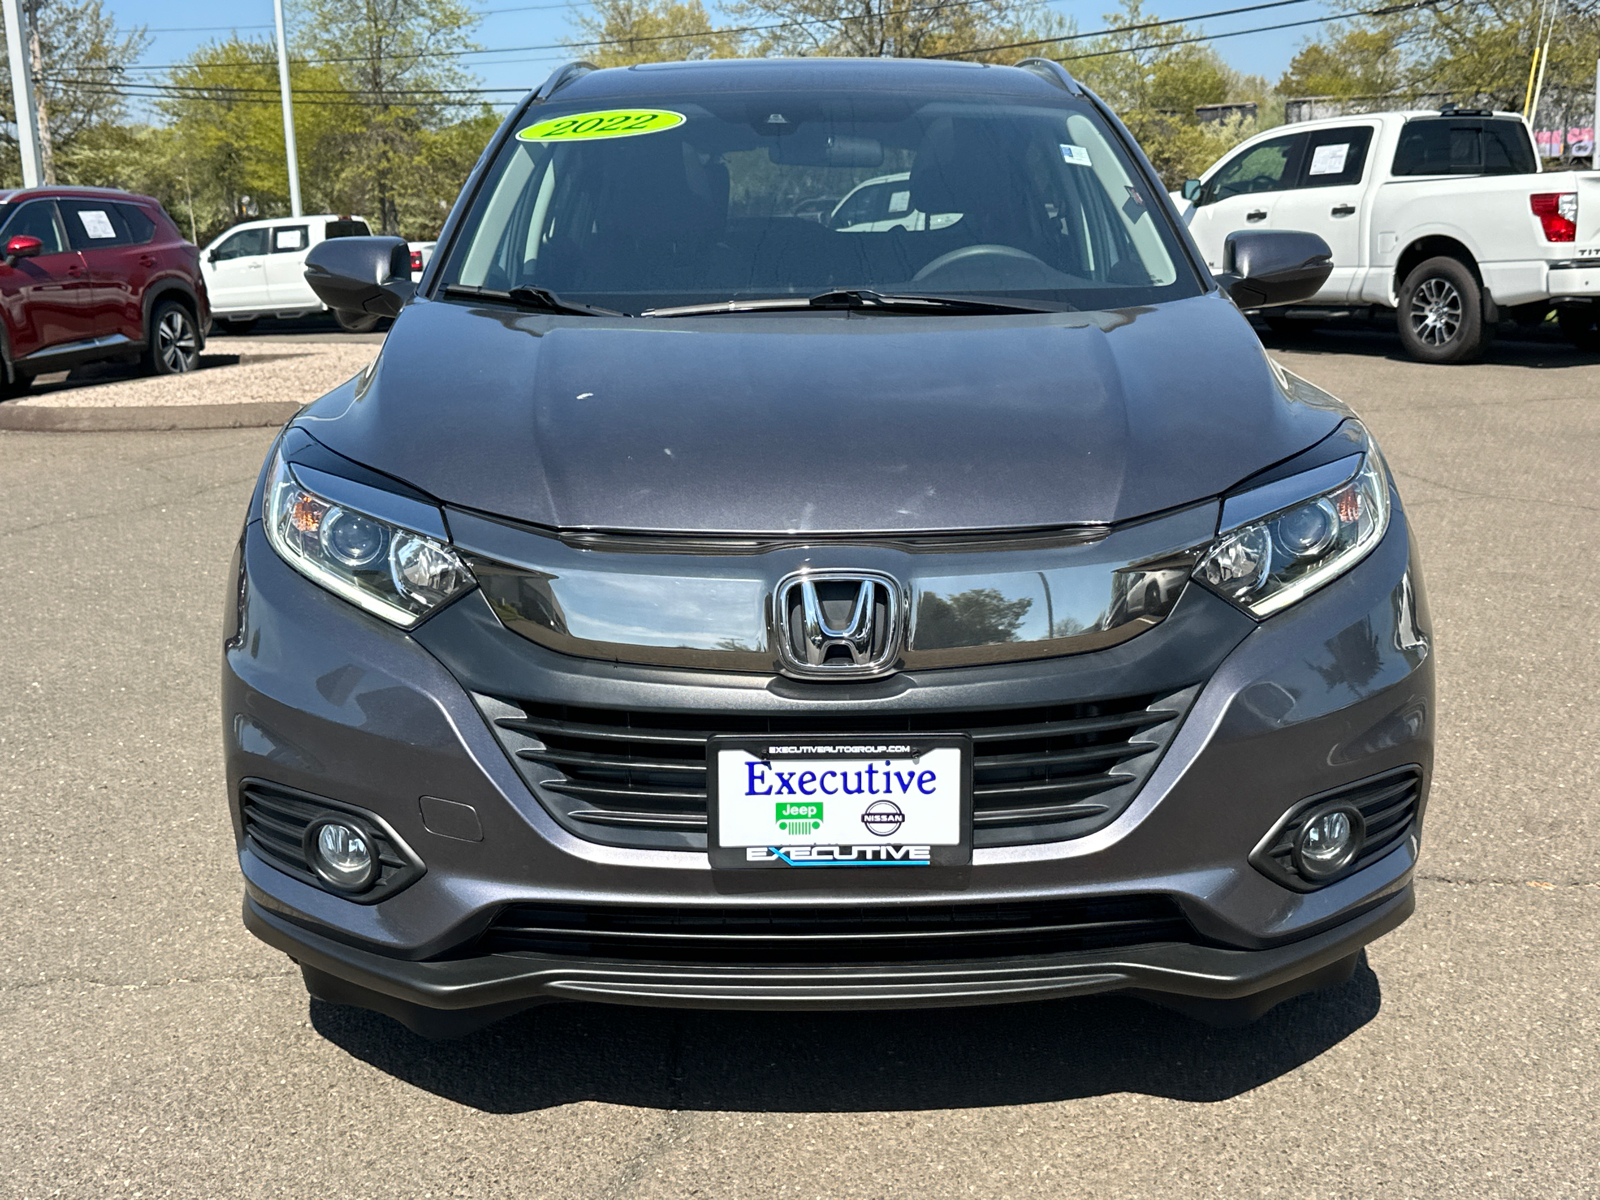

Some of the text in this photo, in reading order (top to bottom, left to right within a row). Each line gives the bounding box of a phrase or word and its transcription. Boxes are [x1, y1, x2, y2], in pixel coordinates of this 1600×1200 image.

[540, 113, 659, 138] 2022
[768, 745, 911, 754] EXECUTIVEAUTOGROUP.COM
[744, 759, 937, 796] Executive
[782, 804, 818, 818] Jeep
[863, 814, 903, 823] NISSAN
[746, 845, 931, 862] EXECUTIVE
